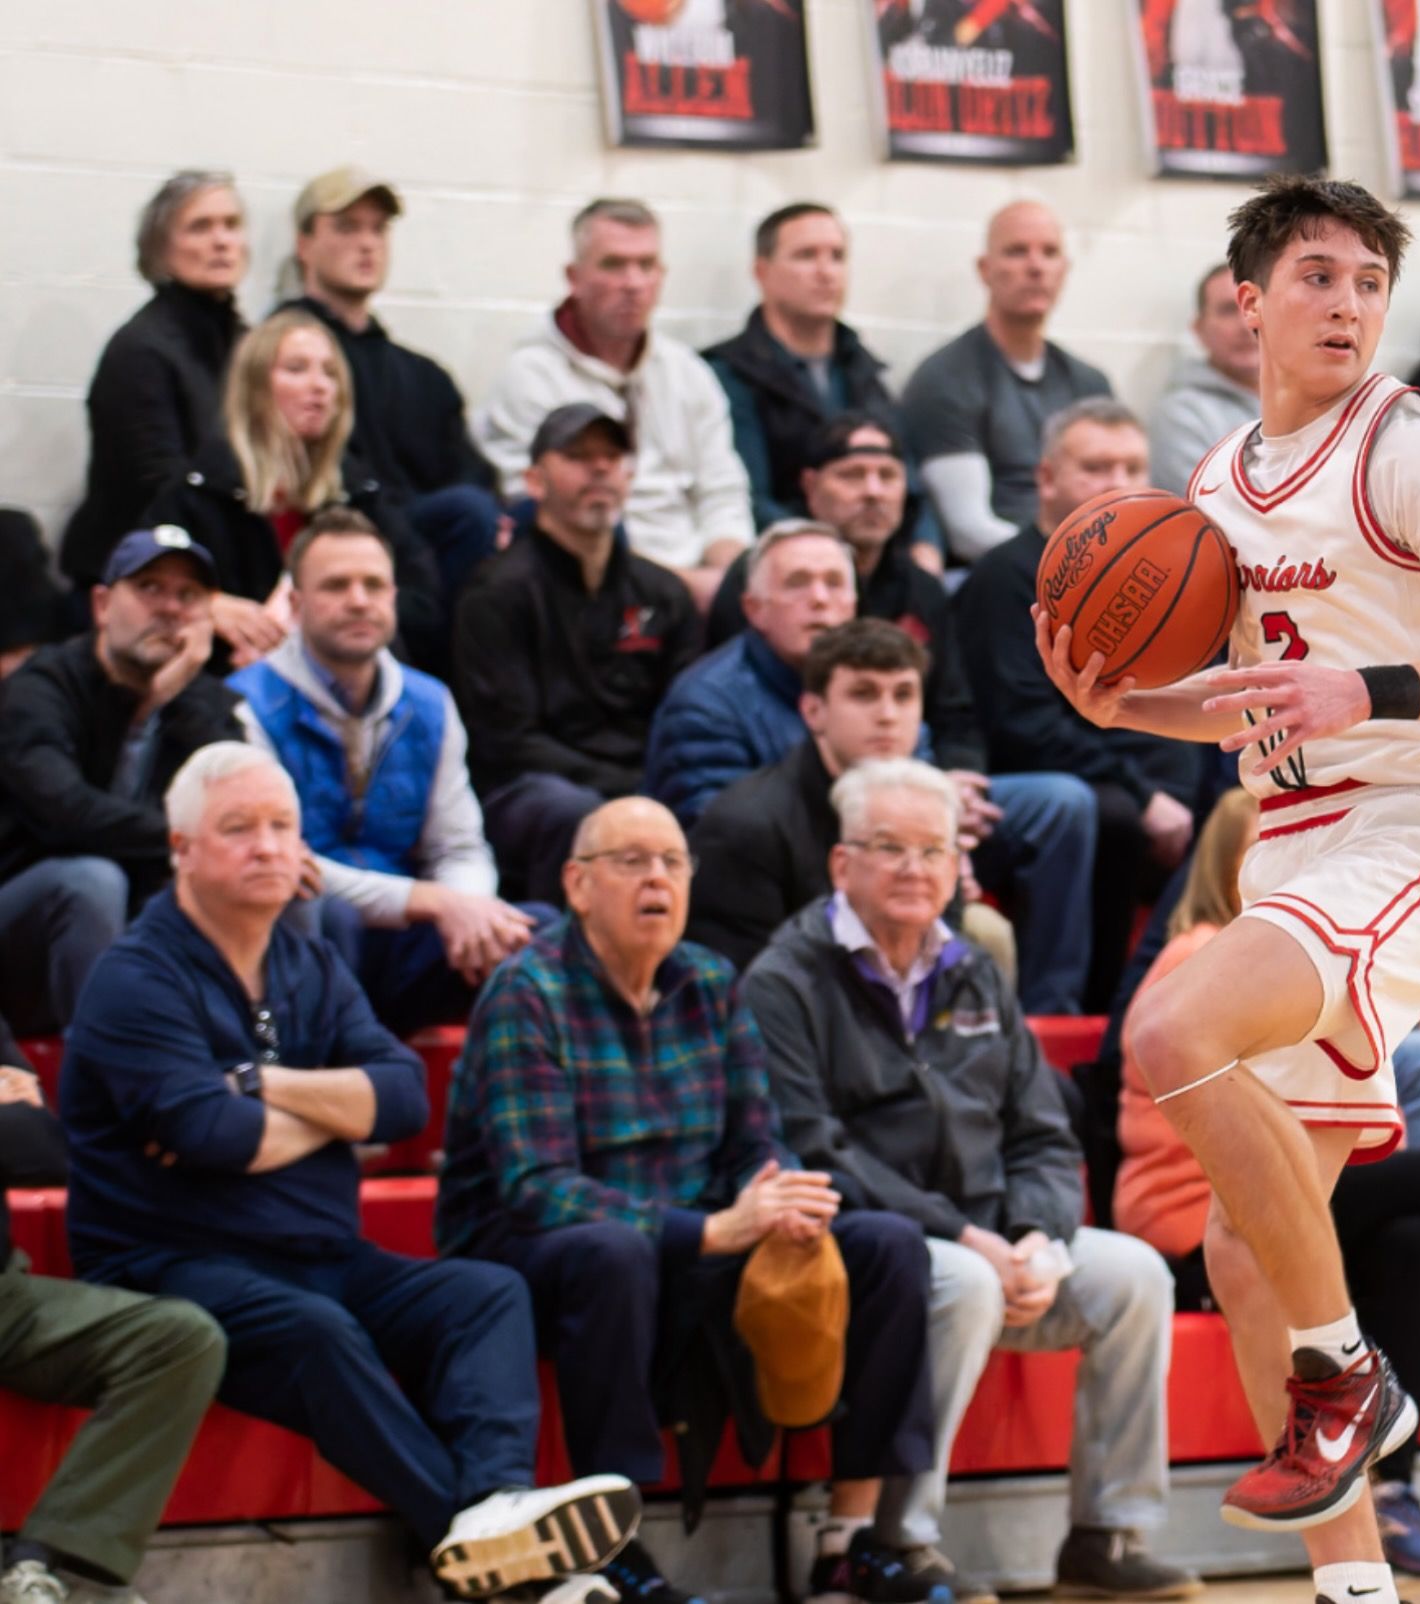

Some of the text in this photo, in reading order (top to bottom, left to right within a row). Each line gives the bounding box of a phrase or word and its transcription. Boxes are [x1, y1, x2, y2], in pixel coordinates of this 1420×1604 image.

[1043, 510, 1117, 620] Rawlings
[1086, 557, 1169, 658] OHSAA
[1233, 551, 1337, 592] rriors
